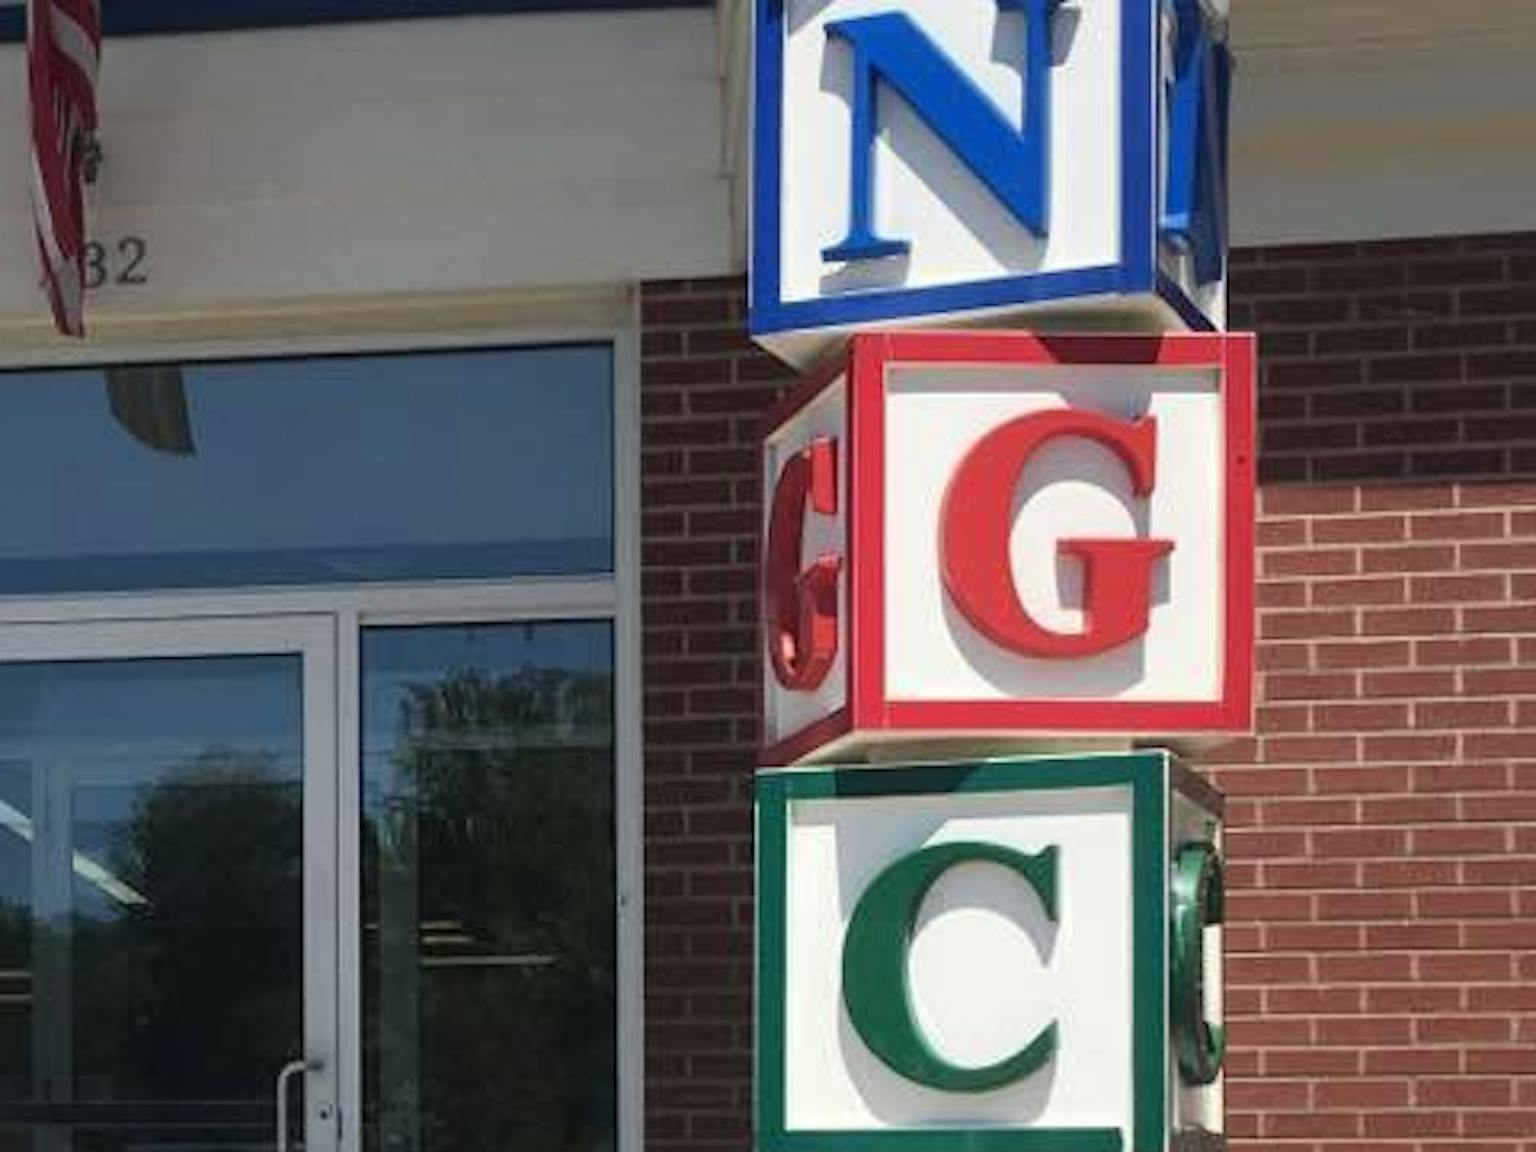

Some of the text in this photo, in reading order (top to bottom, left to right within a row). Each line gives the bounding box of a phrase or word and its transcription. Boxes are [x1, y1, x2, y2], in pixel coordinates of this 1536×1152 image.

[820, 0, 1066, 261] N
[38, 236, 147, 288] 32
[766, 435, 846, 692] G
[939, 407, 1176, 660] G
[842, 840, 1060, 1093] C
